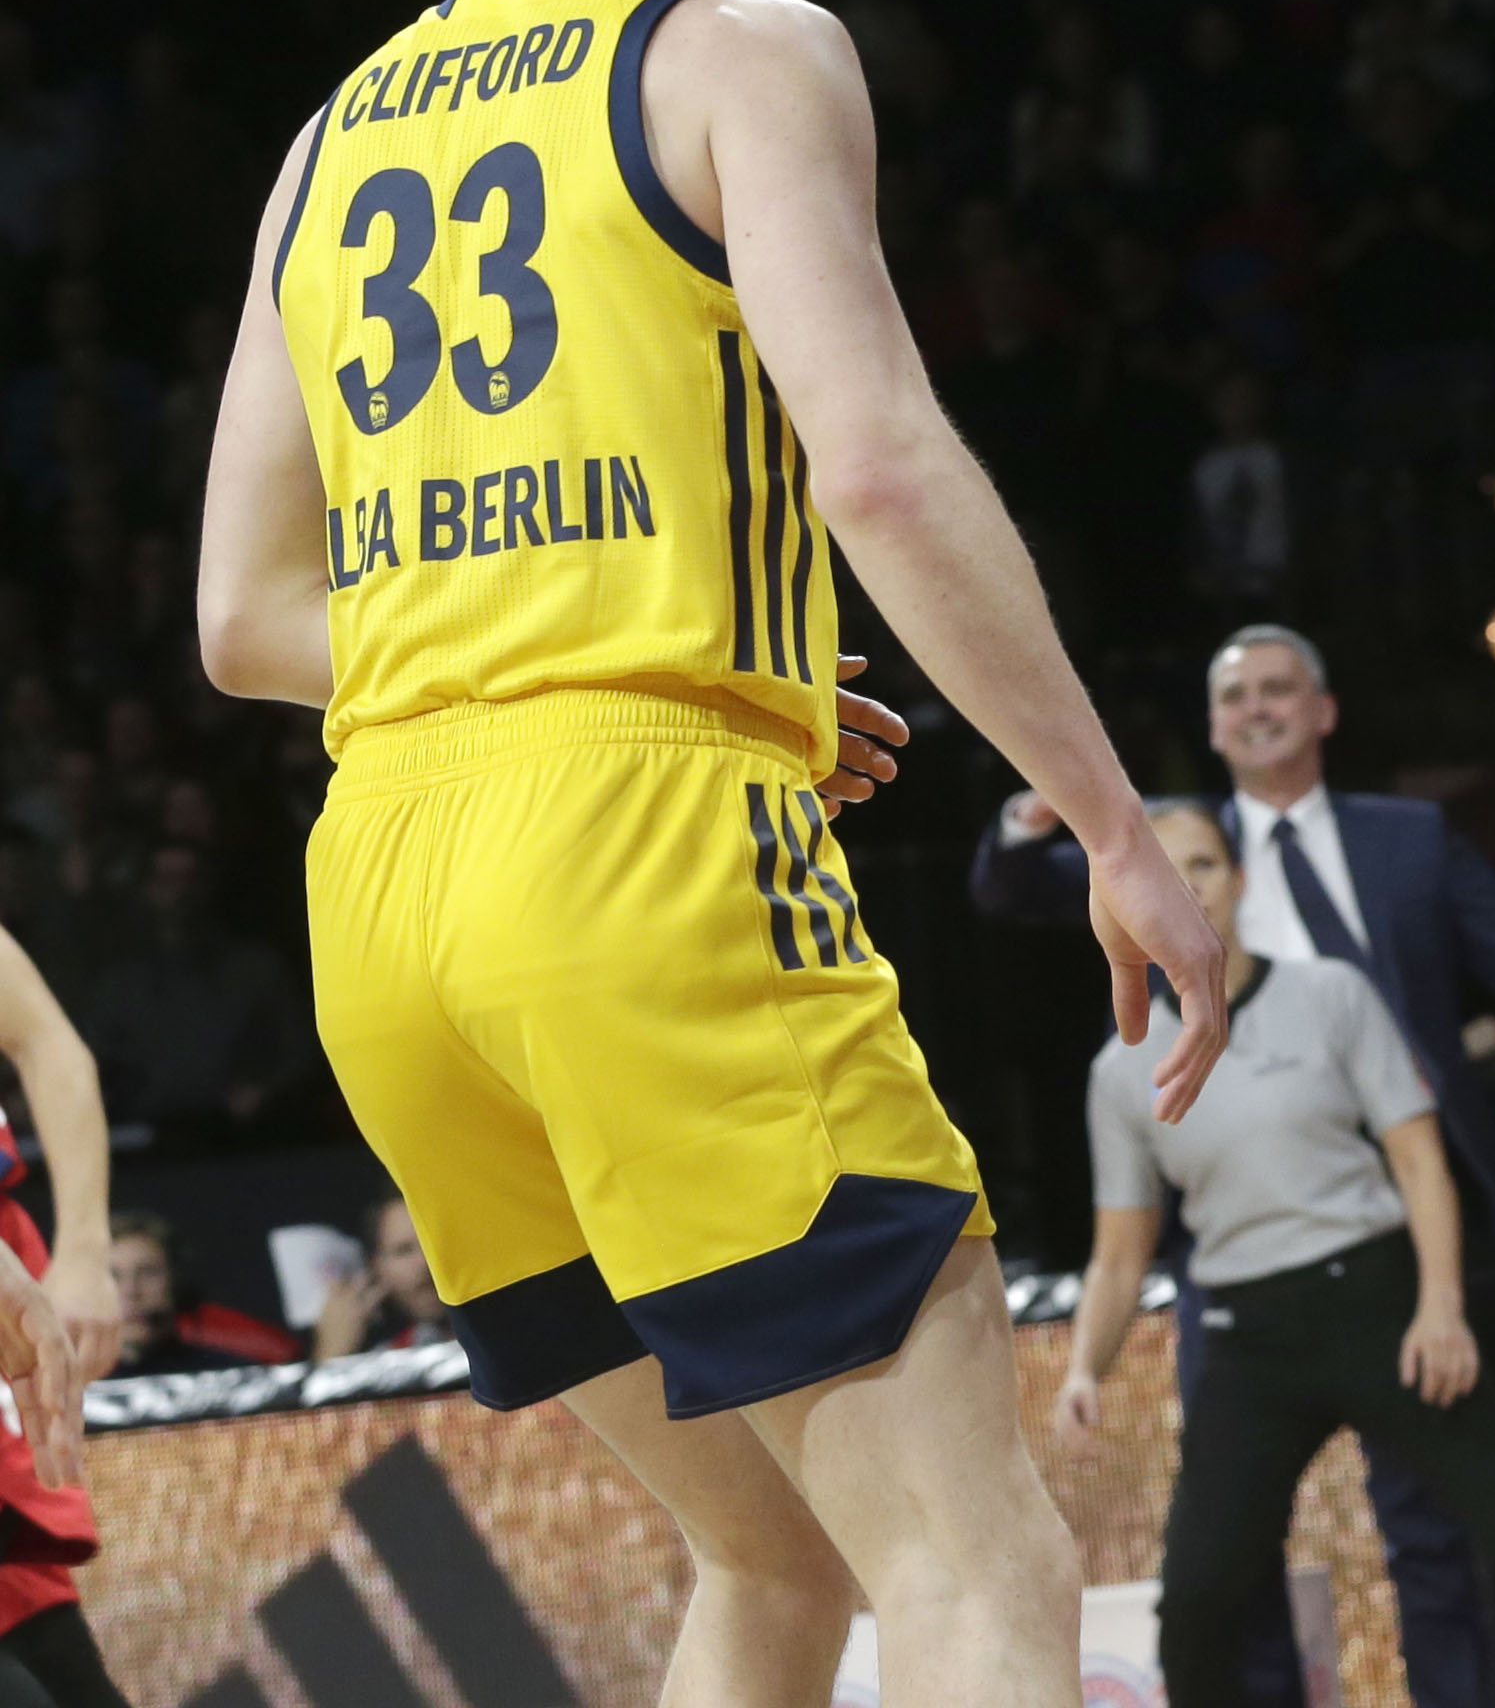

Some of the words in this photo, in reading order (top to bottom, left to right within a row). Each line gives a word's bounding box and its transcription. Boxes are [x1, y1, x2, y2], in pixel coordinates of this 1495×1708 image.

[341, 17, 595, 131] CLIFFORD
[335, 141, 559, 436] 33
[328, 487, 401, 593] LBA
[420, 455, 656, 562] BERLIN
